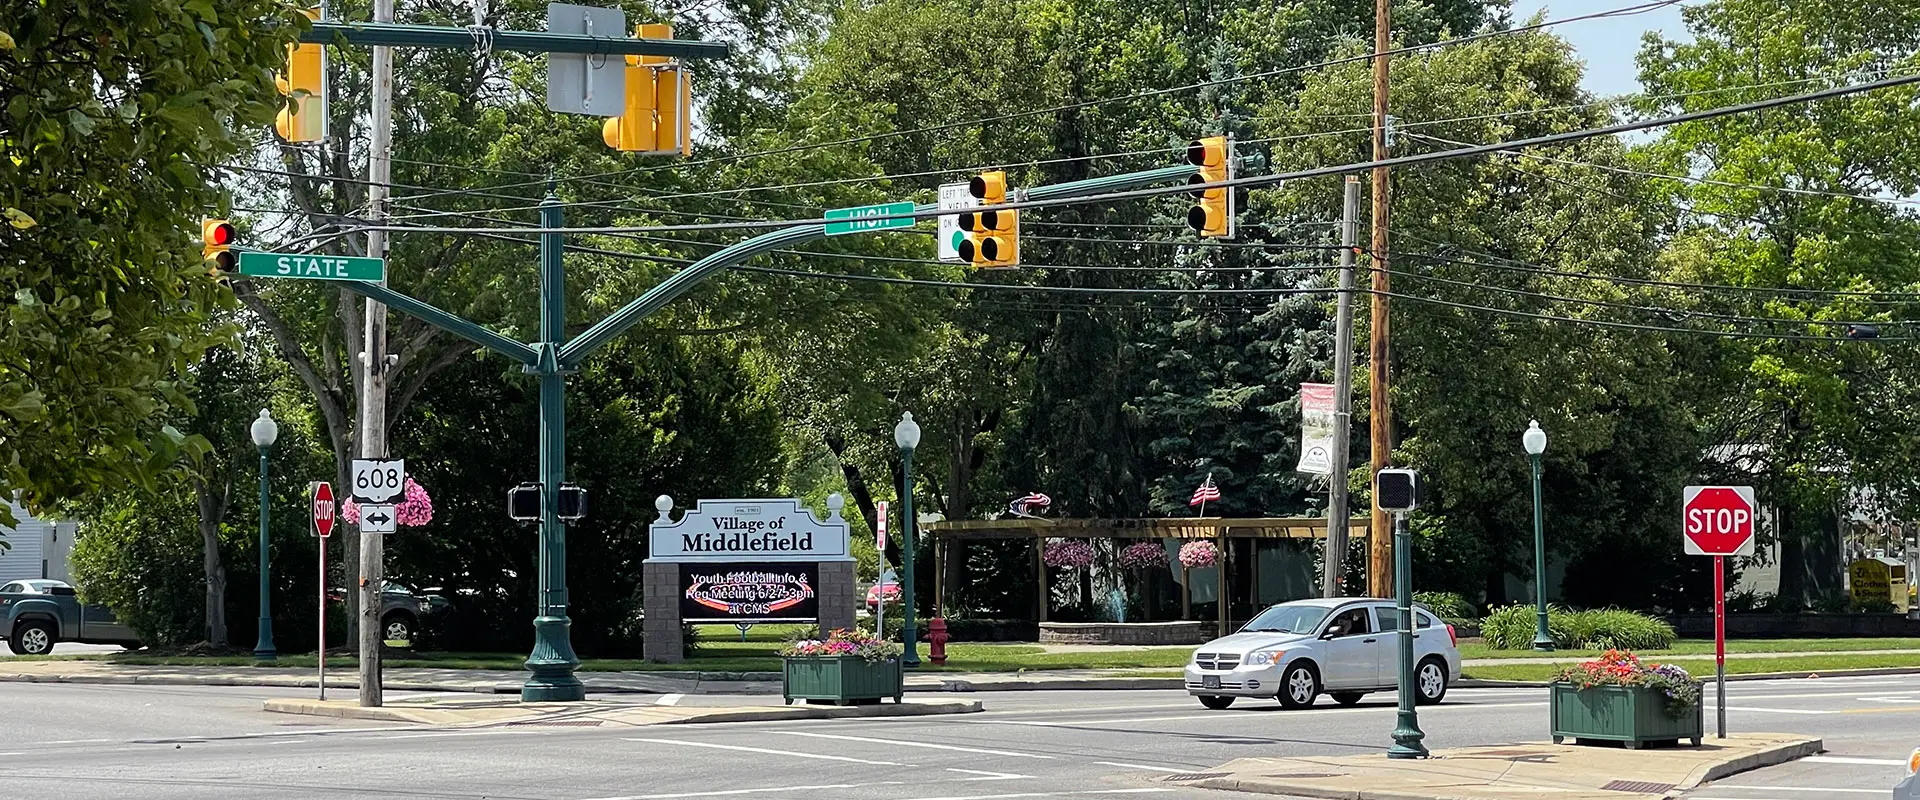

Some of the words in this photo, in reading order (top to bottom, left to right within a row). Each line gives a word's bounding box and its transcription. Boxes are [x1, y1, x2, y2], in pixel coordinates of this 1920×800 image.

[942, 189, 956, 199] LEFT
[849, 207, 890, 229] HIGH
[943, 218, 952, 228] ON
[277, 256, 349, 277] STATE
[356, 469, 398, 488] 608
[315, 499, 333, 520] STOP
[712, 517, 765, 533] Village
[769, 516, 786, 529] of
[1688, 508, 1749, 534] STOP
[682, 532, 813, 551] Middlefield
[690, 573, 724, 584] Youth
[798, 572, 808, 583] &
[711, 588, 756, 601] Meeting
[728, 604, 742, 614] at
[743, 603, 771, 614] CMS
